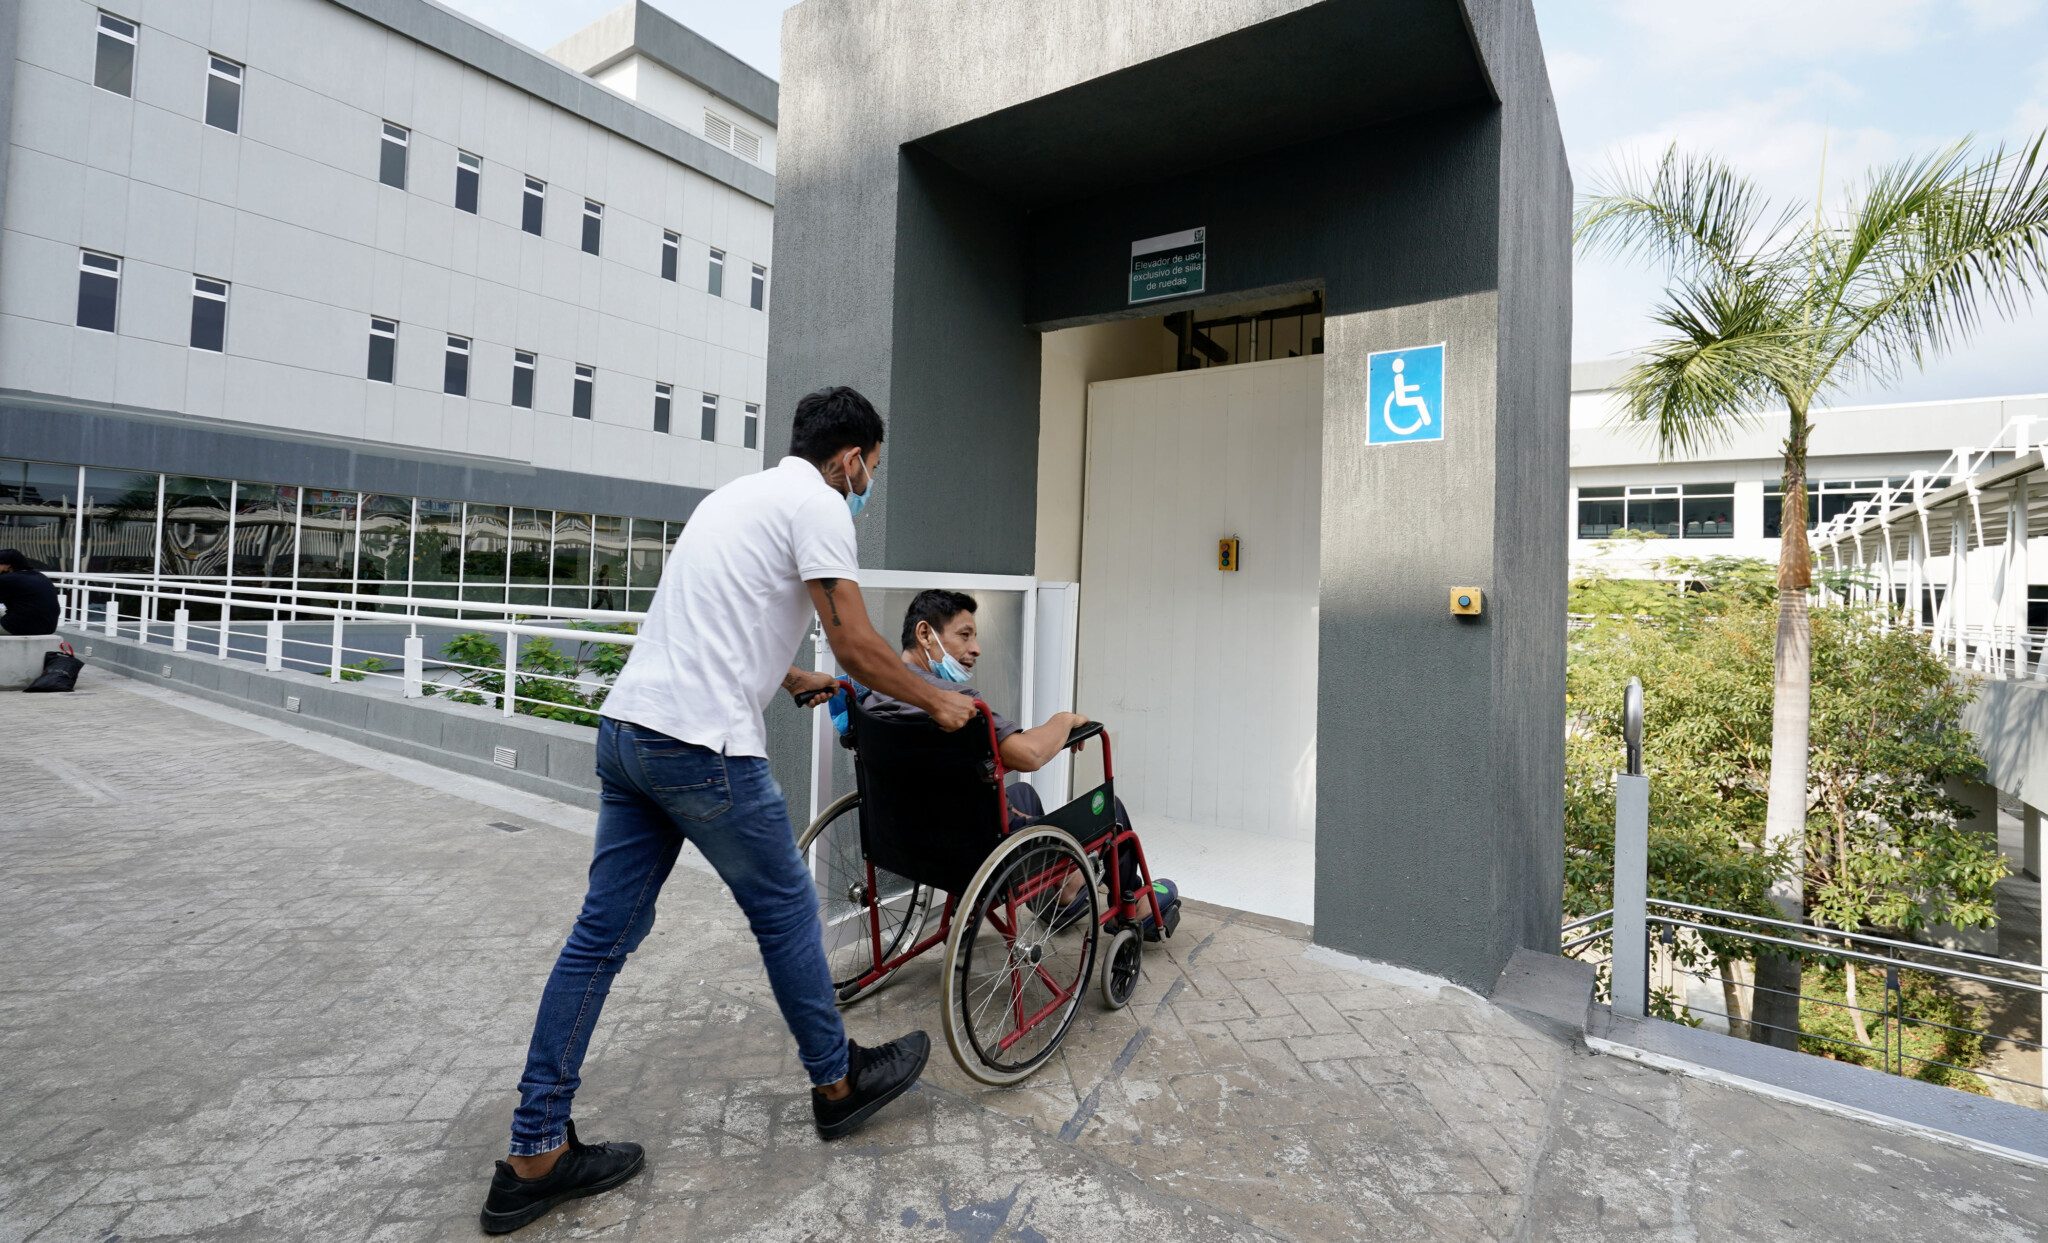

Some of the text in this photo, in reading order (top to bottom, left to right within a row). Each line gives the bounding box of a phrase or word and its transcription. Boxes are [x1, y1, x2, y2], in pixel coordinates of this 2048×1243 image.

[1135, 252, 1201, 270] Elevador de uso
[1133, 263, 1201, 281] exclusivo de silla
[1146, 277, 1188, 291] de ruedas
